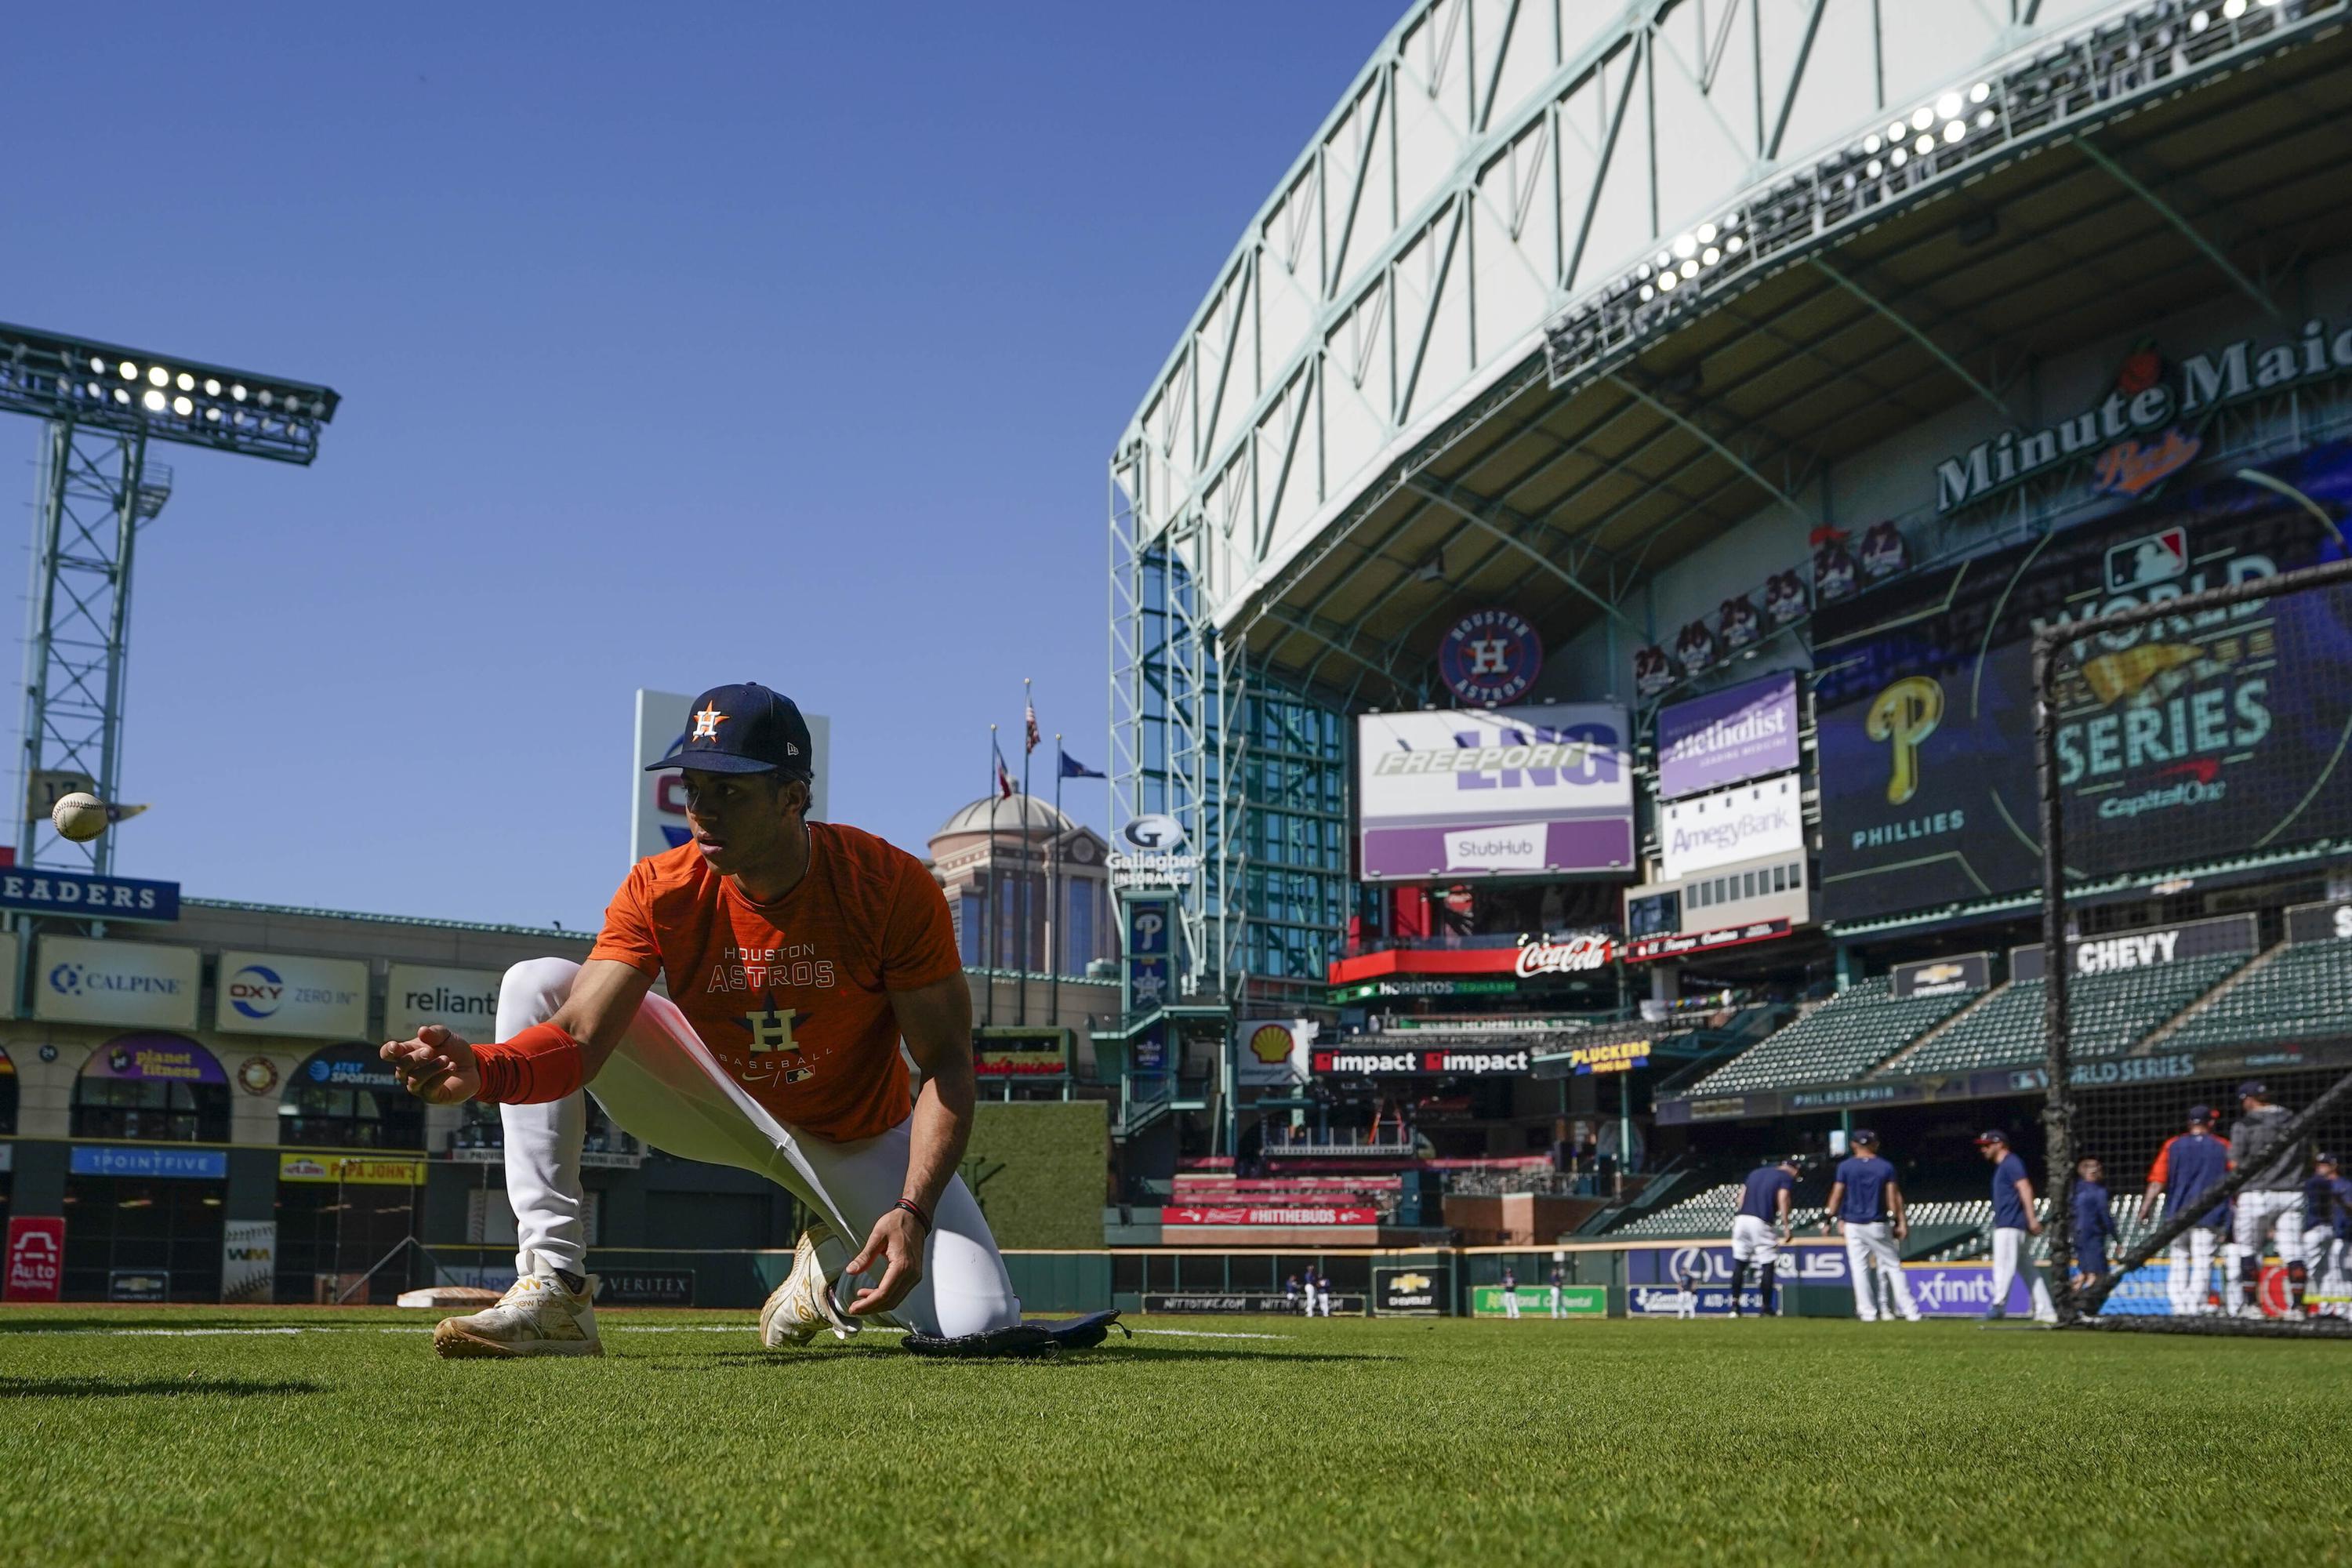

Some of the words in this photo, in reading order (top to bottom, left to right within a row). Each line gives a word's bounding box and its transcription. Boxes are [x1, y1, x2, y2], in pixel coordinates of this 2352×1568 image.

[1936, 386, 2166, 514] Minute
[1450, 611, 1530, 641] HOUSTON
[1471, 639, 1509, 674] H
[1455, 676, 1526, 700] ASTROS
[693, 710, 721, 737] H
[1668, 707, 1788, 764] Methodist
[2056, 679, 2273, 785] SERIES
[1865, 676, 1945, 805] P
[1379, 745, 1576, 774] FREEPORT
[1456, 723, 1620, 790] LNG
[1852, 809, 1965, 850] PHILLIES
[1458, 840, 1534, 858] StubHub
[1105, 852, 1201, 872] Gallagher
[1114, 872, 1192, 885] INSURANCE
[724, 943, 815, 961] HOUSTON
[2076, 930, 2180, 975] CHEVY
[86, 973, 180, 995] CALPINE
[706, 960, 835, 993] ASTROS
[229, 983, 284, 1000] OXY
[294, 988, 332, 1004] ZERO
[1379, 982, 1454, 996] HORNITOS
[405, 987, 496, 1016] reliant
[746, 1008, 800, 1052] H
[135, 1049, 192, 1065] planet
[719, 1047, 833, 1069] BASEBALL
[1333, 1049, 1417, 1075] impact
[1443, 1048, 1529, 1074] impact
[1570, 1040, 1652, 1064] PLUCKERS
[142, 1064, 201, 1079] fitness
[2117, 1054, 2195, 1081] SERIES
[1794, 1087, 1894, 1106] PHILADELPHIA
[93, 1154, 209, 1171] 1POINTFIVE
[367, 1163, 416, 1178] JOHN'S
[1250, 1208, 1336, 1224] #HITTHEBUDS
[12, 1263, 56, 1279] Auto
[1714, 1253, 1846, 1278] LUS
[610, 1277, 687, 1293] VERITEX
[1388, 1296, 1433, 1306] CHEVROLET
